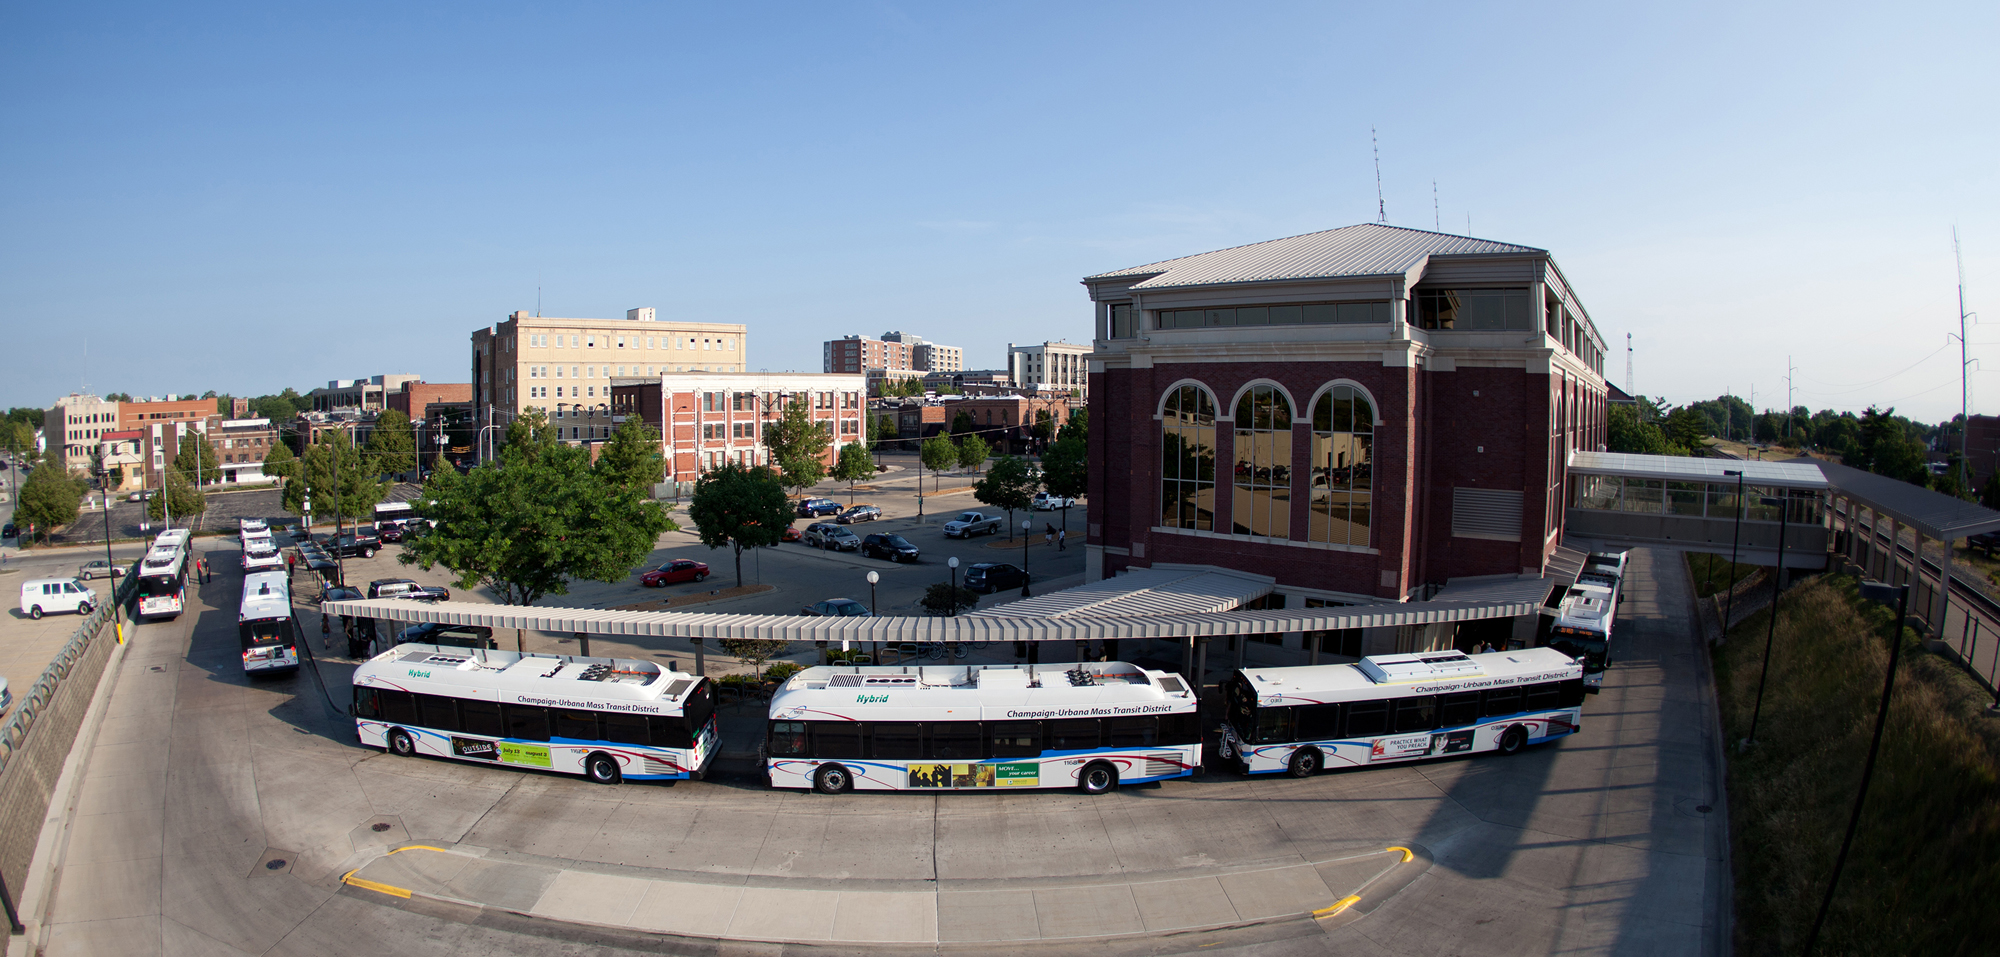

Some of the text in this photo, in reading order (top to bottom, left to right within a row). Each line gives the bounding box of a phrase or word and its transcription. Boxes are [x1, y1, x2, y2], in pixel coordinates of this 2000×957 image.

[408, 669, 431, 679] Hybrid
[1516, 675, 1542, 683] Transit
[1542, 671, 1569, 681] District
[517, 695, 659, 714] Champaign-Urbana Mass Transit District
[856, 694, 889, 704] Hybrid
[1007, 704, 1172, 719] Champaign-Urbana Mass Transit District
[462, 743, 492, 752] OUTSIDE
